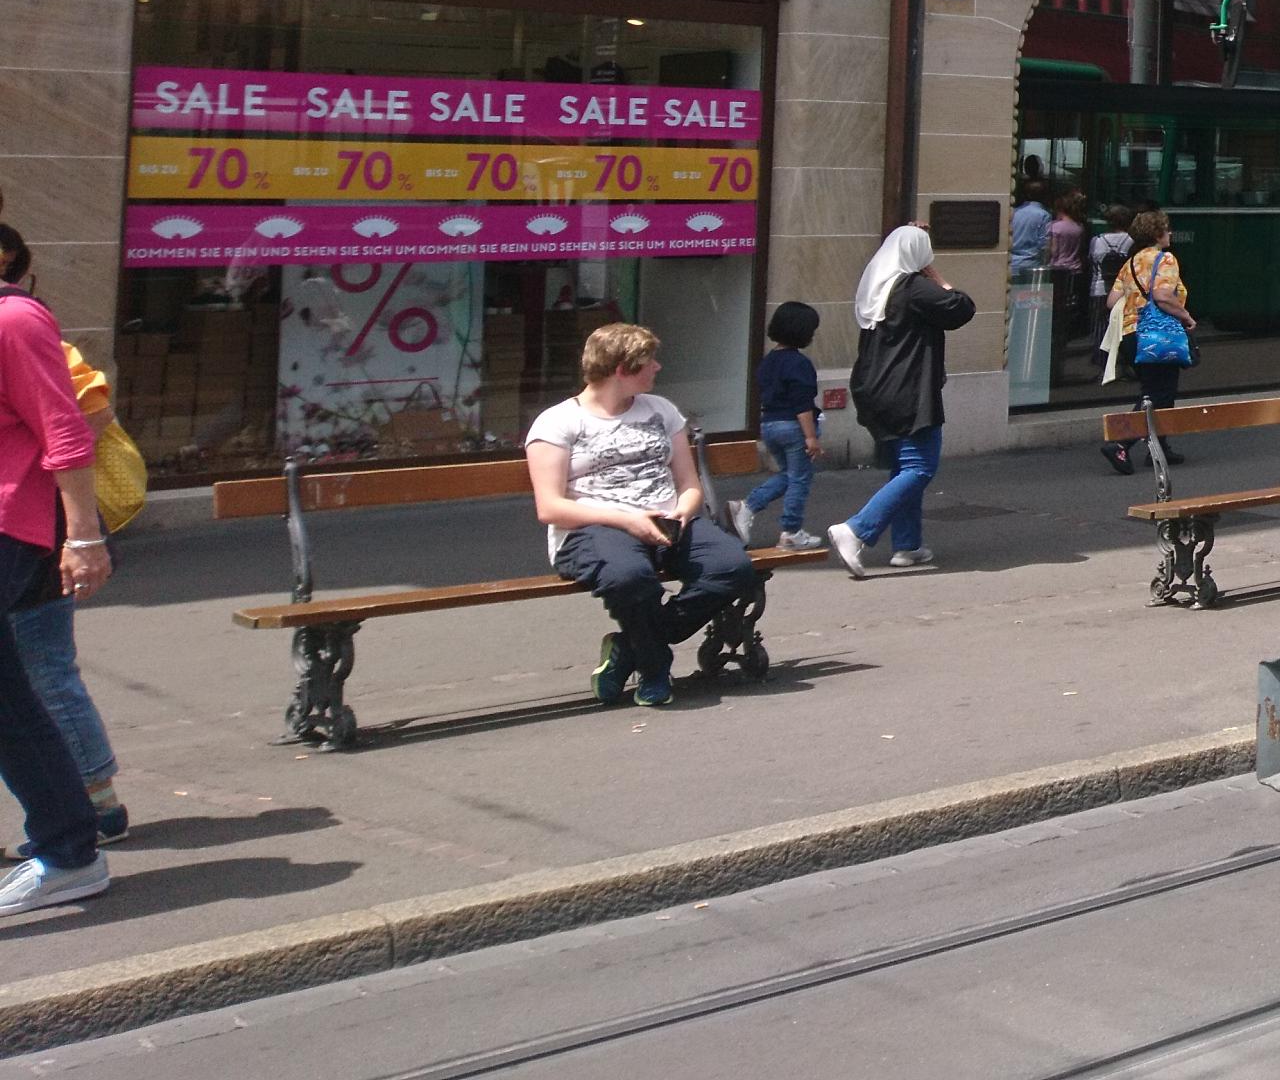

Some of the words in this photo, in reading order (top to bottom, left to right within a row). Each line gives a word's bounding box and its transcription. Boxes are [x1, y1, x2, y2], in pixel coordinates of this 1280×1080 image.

[154, 80, 268, 116] SALE
[306, 87, 410, 121] SALE
[429, 92, 526, 124] SALE
[558, 95, 648, 126] SALE
[663, 99, 747, 129] SALE
[708, 156, 753, 192] 70
[127, 247, 197, 259] KOMMEN
[200, 248, 220, 257] SIE
[224, 247, 257, 258] REIN
[260, 246, 291, 257] UND
[294, 245, 336, 257] SEHEN
[340, 246, 359, 256] SIE
[362, 245, 392, 256] SICH
[396, 245, 415, 255] UM
[418, 243, 477, 255] KOMMEN
[479, 244, 497, 253] SIE
[500, 243, 528, 253] REIN
[531, 242, 557, 252] UND
[559, 242, 597, 252] SEHEN
[599, 241, 615, 251] SIE
[618, 241, 644, 250] SICH
[647, 240, 664, 249] UM
[669, 238, 719, 249] KOMMEN
[721, 238, 736, 248] SIE
